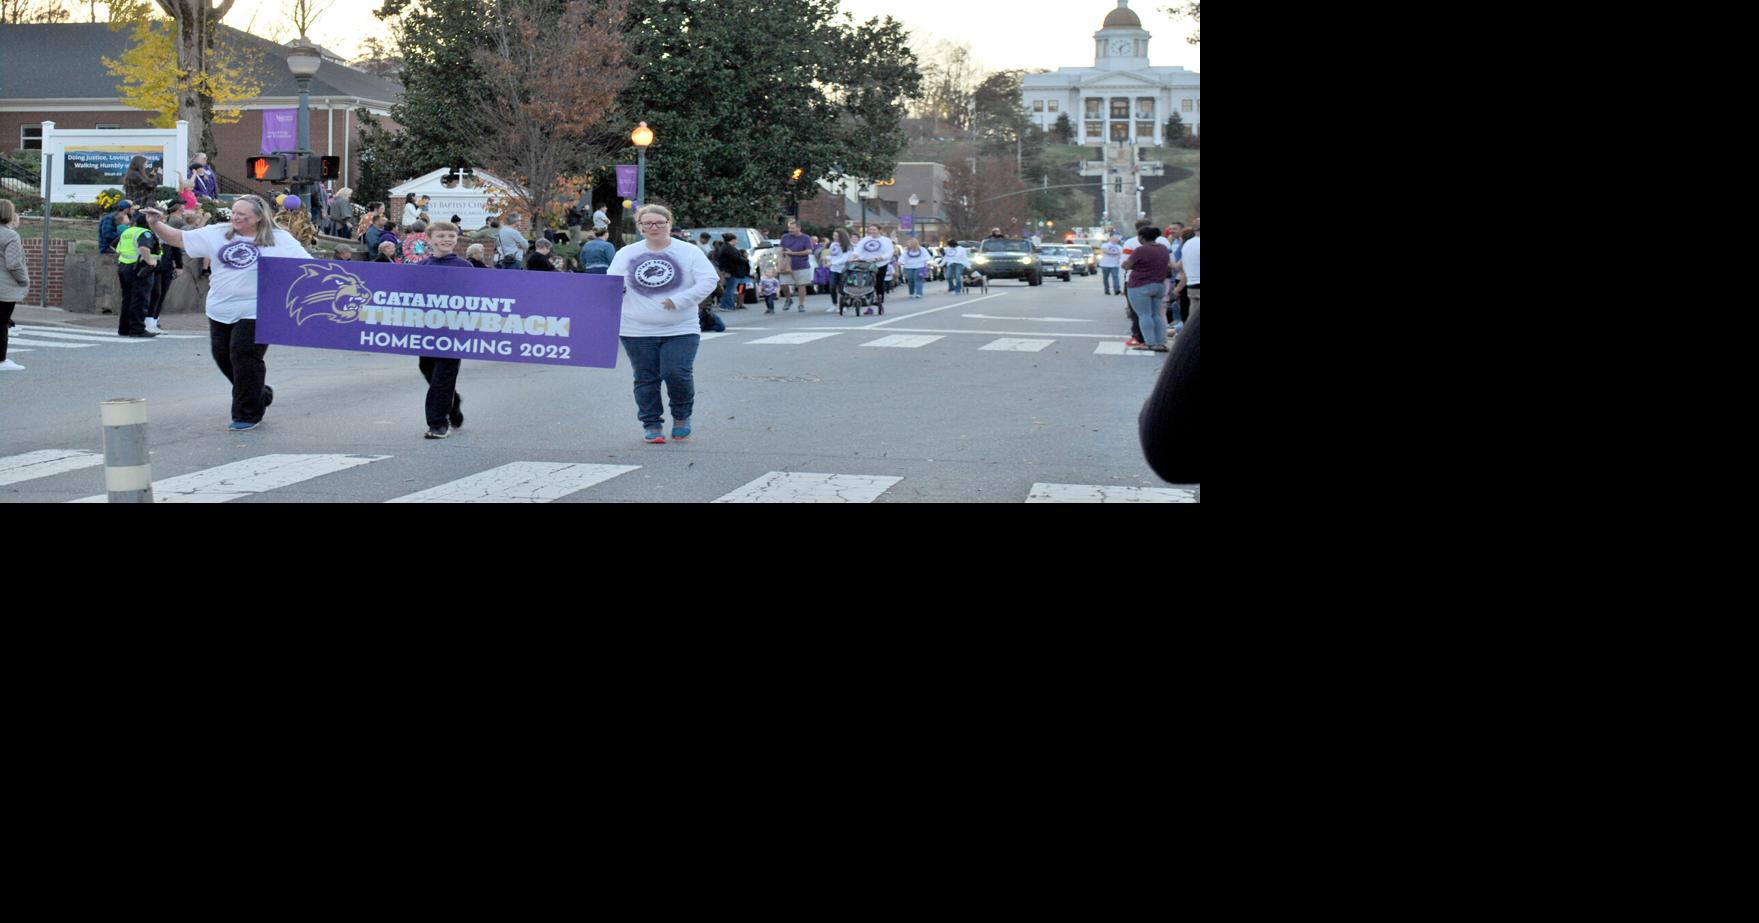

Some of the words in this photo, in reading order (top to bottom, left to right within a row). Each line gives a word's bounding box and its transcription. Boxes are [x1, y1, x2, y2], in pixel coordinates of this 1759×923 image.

[67, 154, 86, 162] Doing
[86, 154, 107, 162] Justice,
[109, 154, 129, 162] Loving
[373, 291, 516, 313] CATAMOUNT
[361, 305, 570, 337] THROWBACK
[360, 331, 513, 355] HOMECOMING
[520, 343, 571, 360] 2022
